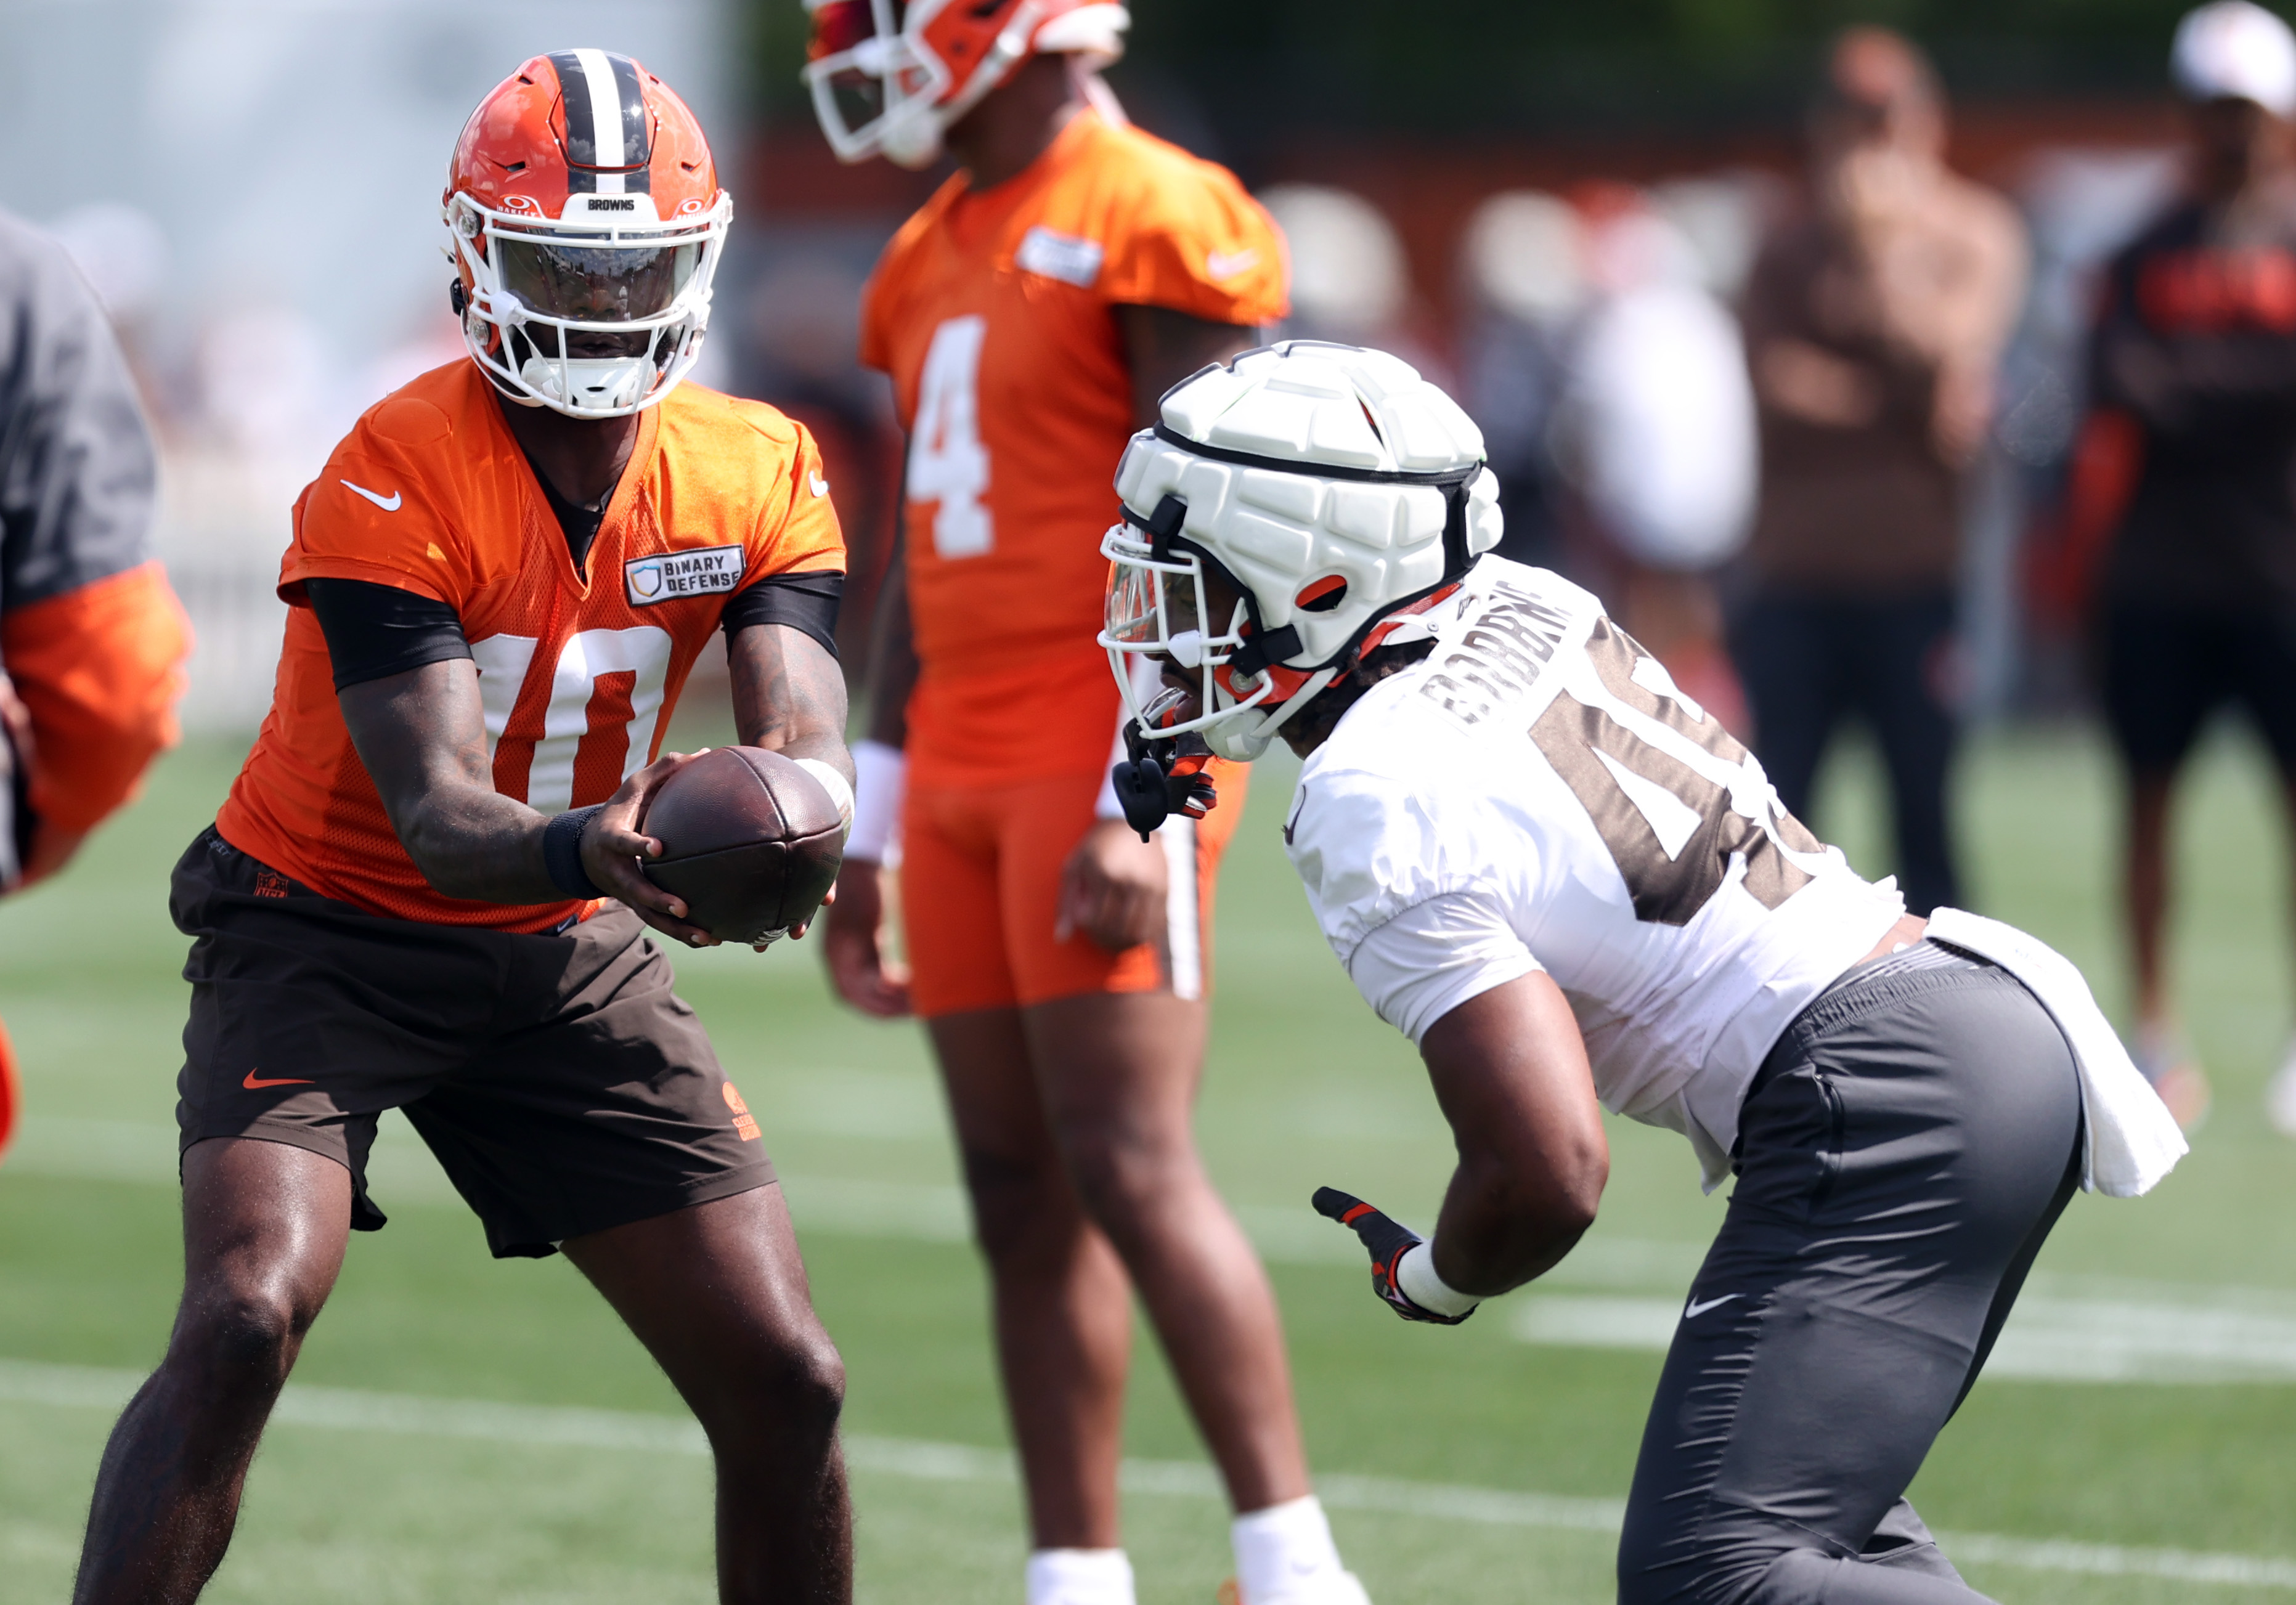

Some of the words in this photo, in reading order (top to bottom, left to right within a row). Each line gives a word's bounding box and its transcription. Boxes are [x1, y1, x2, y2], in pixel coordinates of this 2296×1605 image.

[499, 205, 536, 217] OAKLEY
[588, 199, 635, 211] BROWNS
[906, 312, 995, 559] 4
[664, 556, 724, 576] BINARY
[666, 571, 740, 592] DEFENSE
[470, 626, 672, 816] 10
[738, 1124, 762, 1142] BROWN
